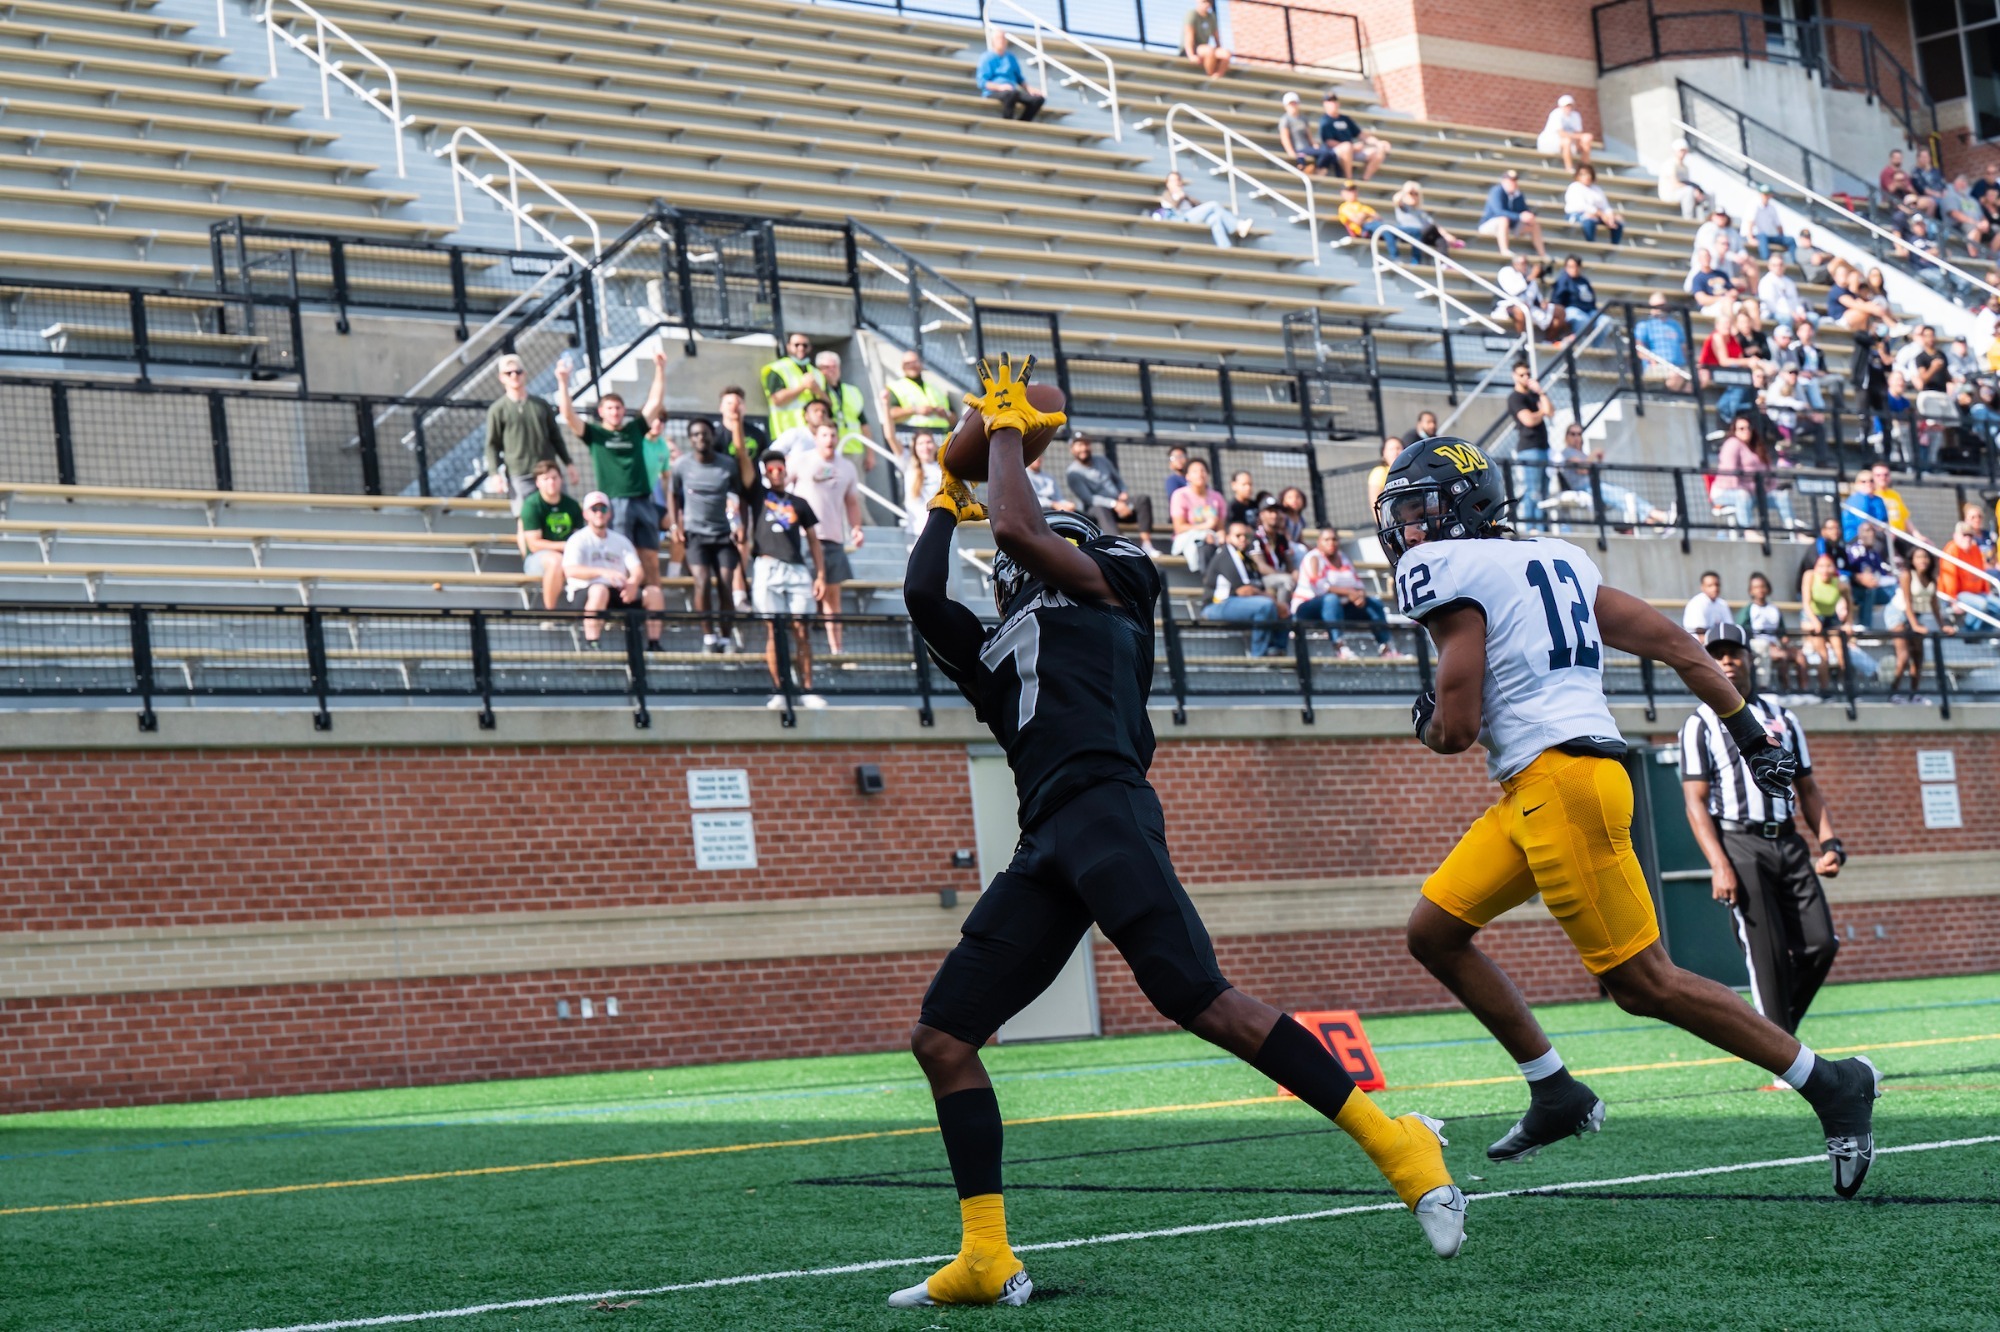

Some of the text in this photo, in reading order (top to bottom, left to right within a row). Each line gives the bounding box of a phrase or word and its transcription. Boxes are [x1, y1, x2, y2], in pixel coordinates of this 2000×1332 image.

[1433, 441, 1488, 474] W
[1398, 562, 1437, 613] 12
[1525, 558, 1600, 671] 12
[980, 611, 1041, 732] 7
[1319, 1022, 1375, 1081] G
